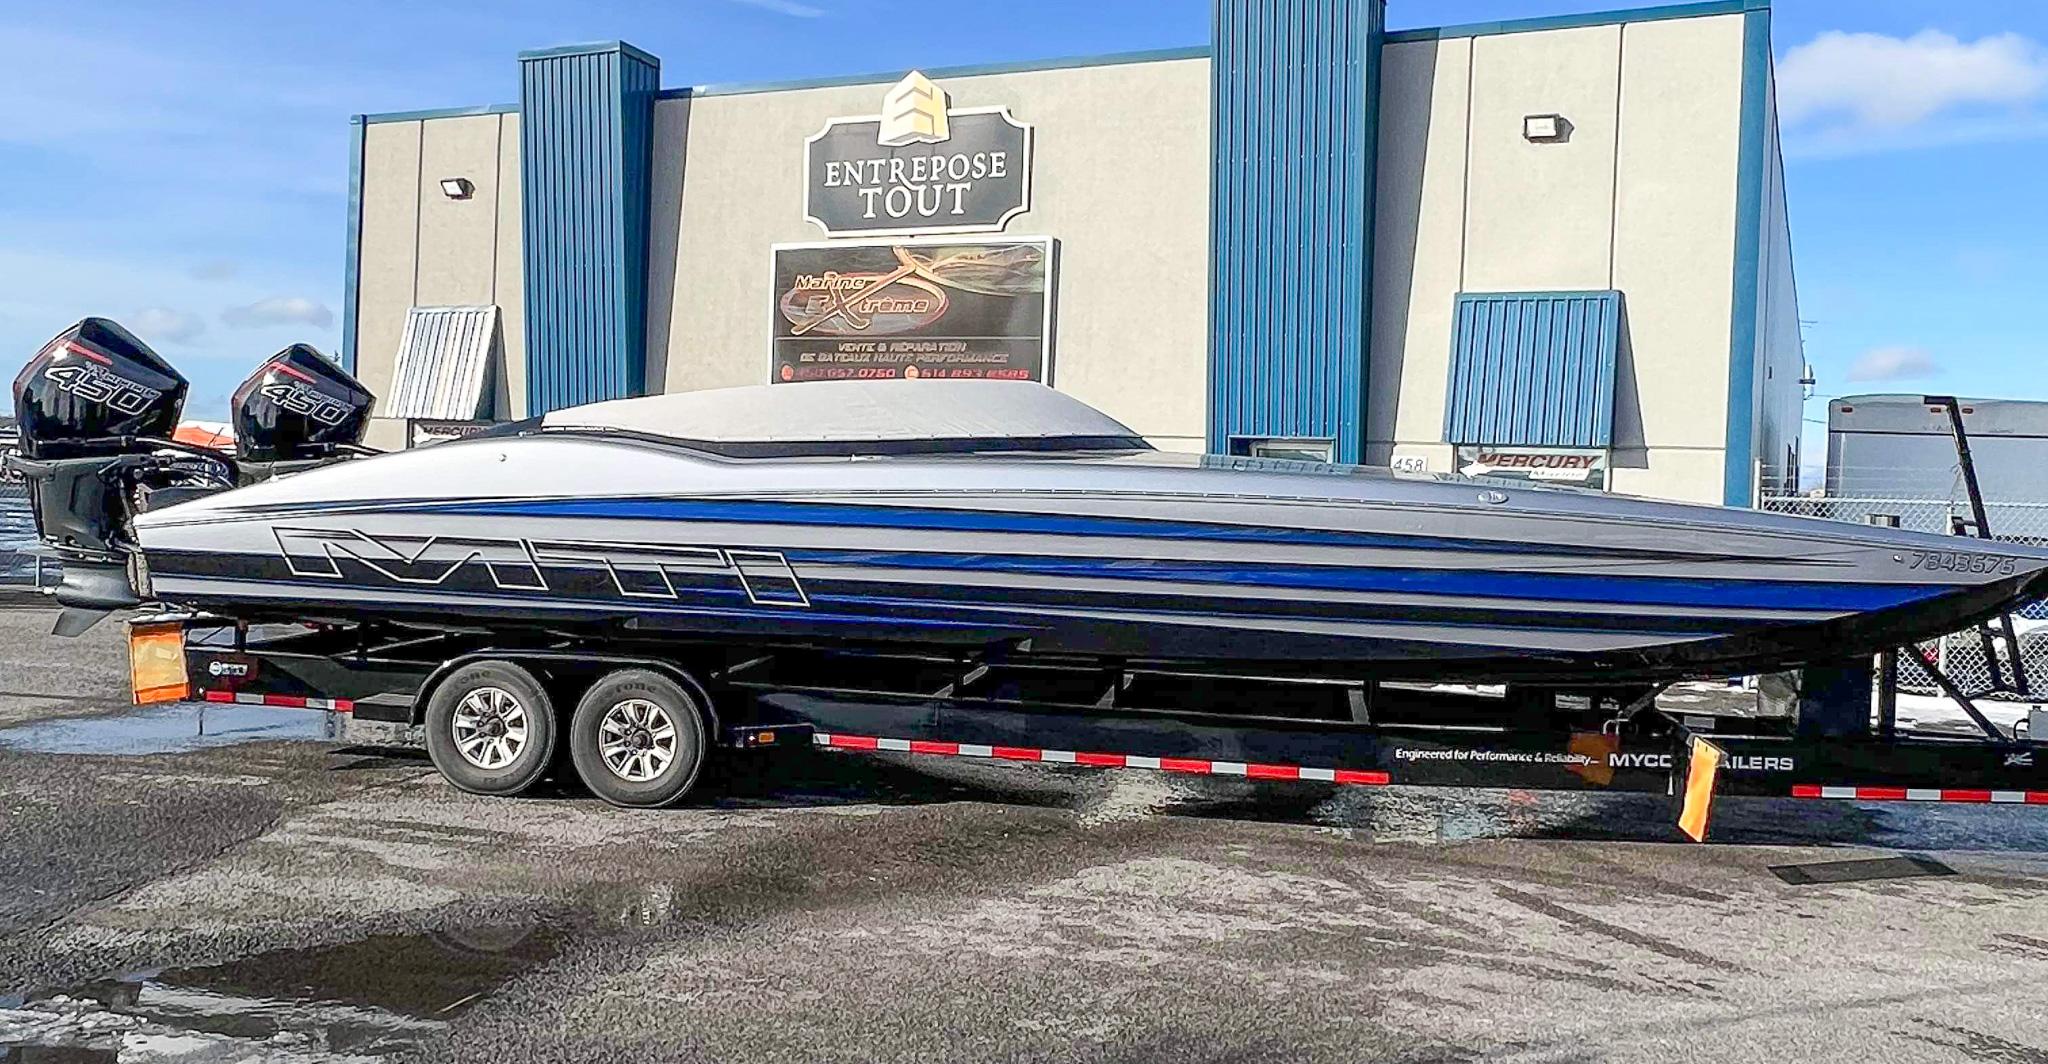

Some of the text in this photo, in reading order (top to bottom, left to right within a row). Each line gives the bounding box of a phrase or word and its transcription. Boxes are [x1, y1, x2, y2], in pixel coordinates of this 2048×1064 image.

[824, 152, 1007, 190] ENTREPOSE
[859, 182, 971, 218] TOUT
[796, 274, 866, 290] Marine
[44, 366, 162, 415] 450
[260, 384, 355, 425] 450
[1393, 459, 1424, 472] 458
[1477, 453, 1599, 469] MERCURY
[1395, 748, 1452, 761] Engineered
[1454, 749, 1469, 760] for
[1470, 750, 1533, 762] Performance
[1534, 753, 1543, 763] &
